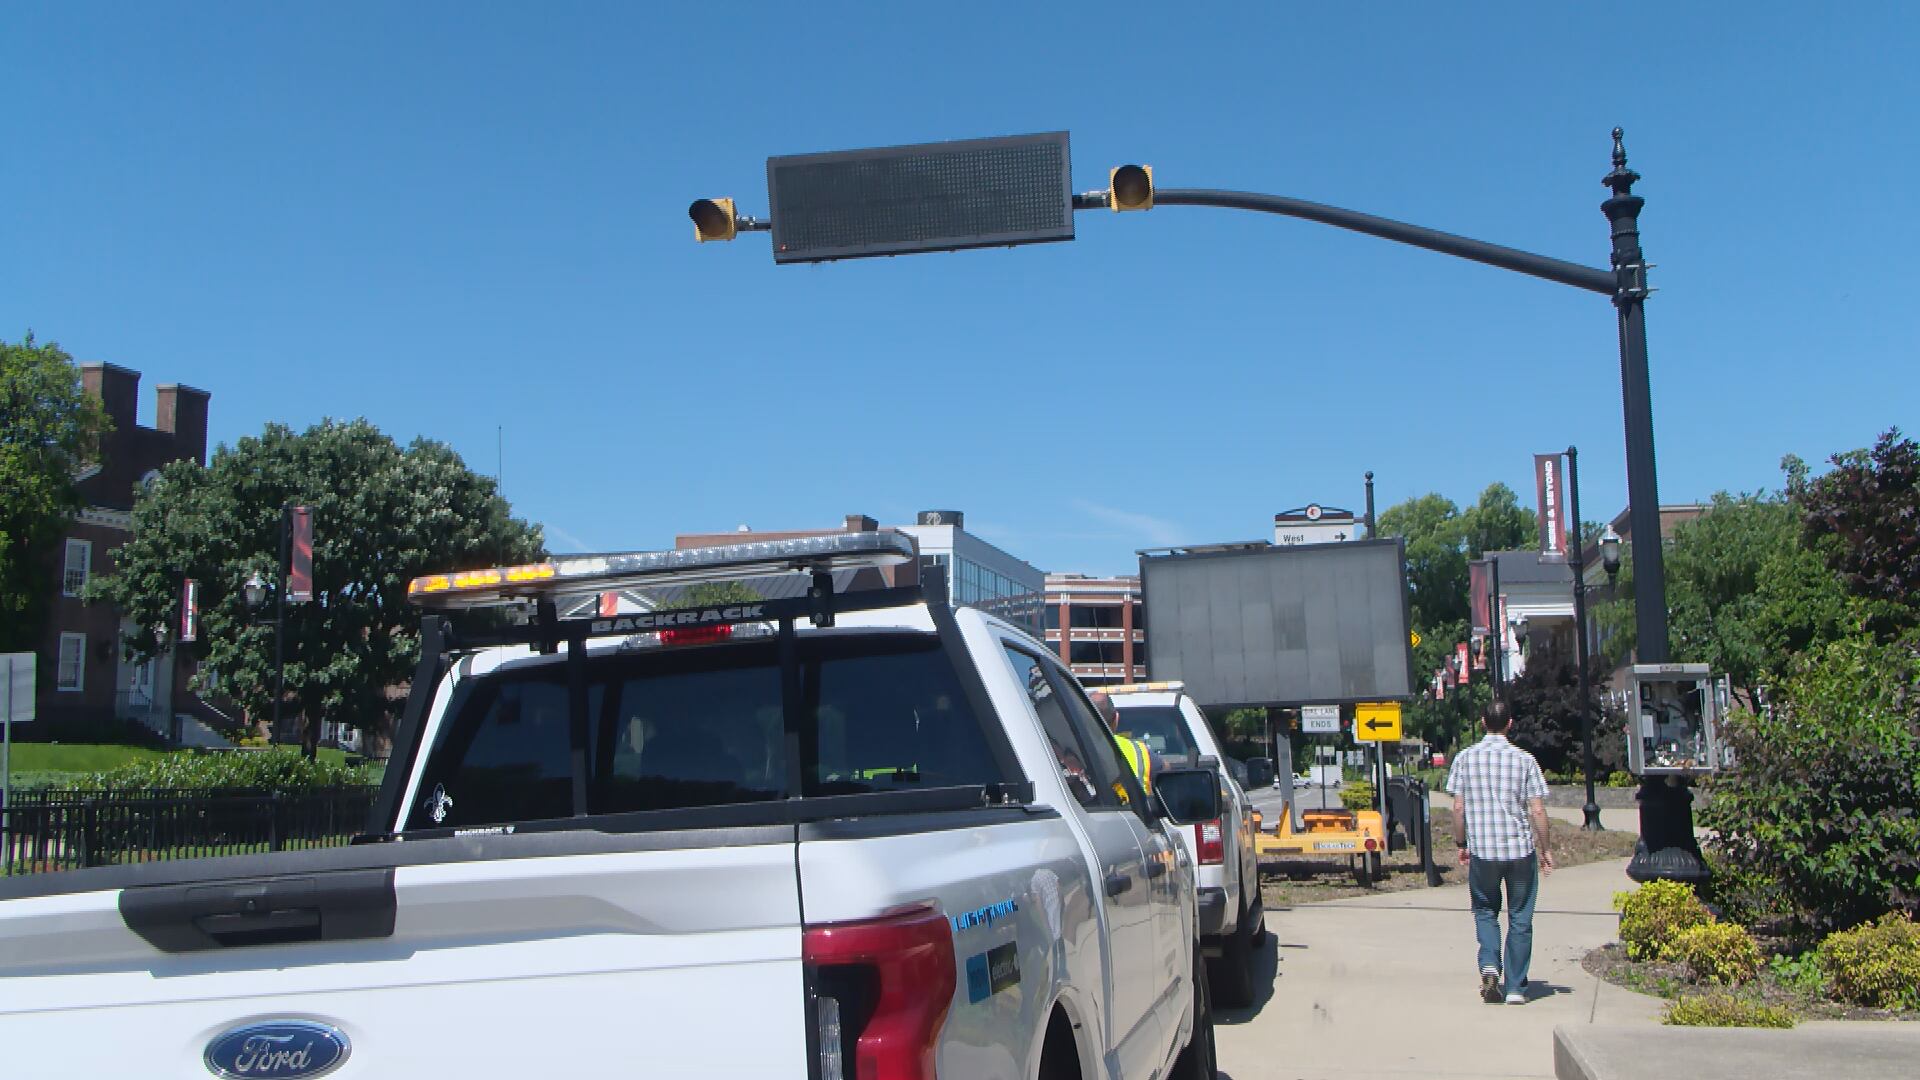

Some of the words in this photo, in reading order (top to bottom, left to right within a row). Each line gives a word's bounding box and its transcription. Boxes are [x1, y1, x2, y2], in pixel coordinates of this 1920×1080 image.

[1545, 460, 1555, 506] BEYOND
[1283, 534, 1304, 542] West
[591, 605, 763, 632] BACKRACK
[1310, 720, 1331, 728] ENDS
[235, 1034, 314, 1072] Ford
